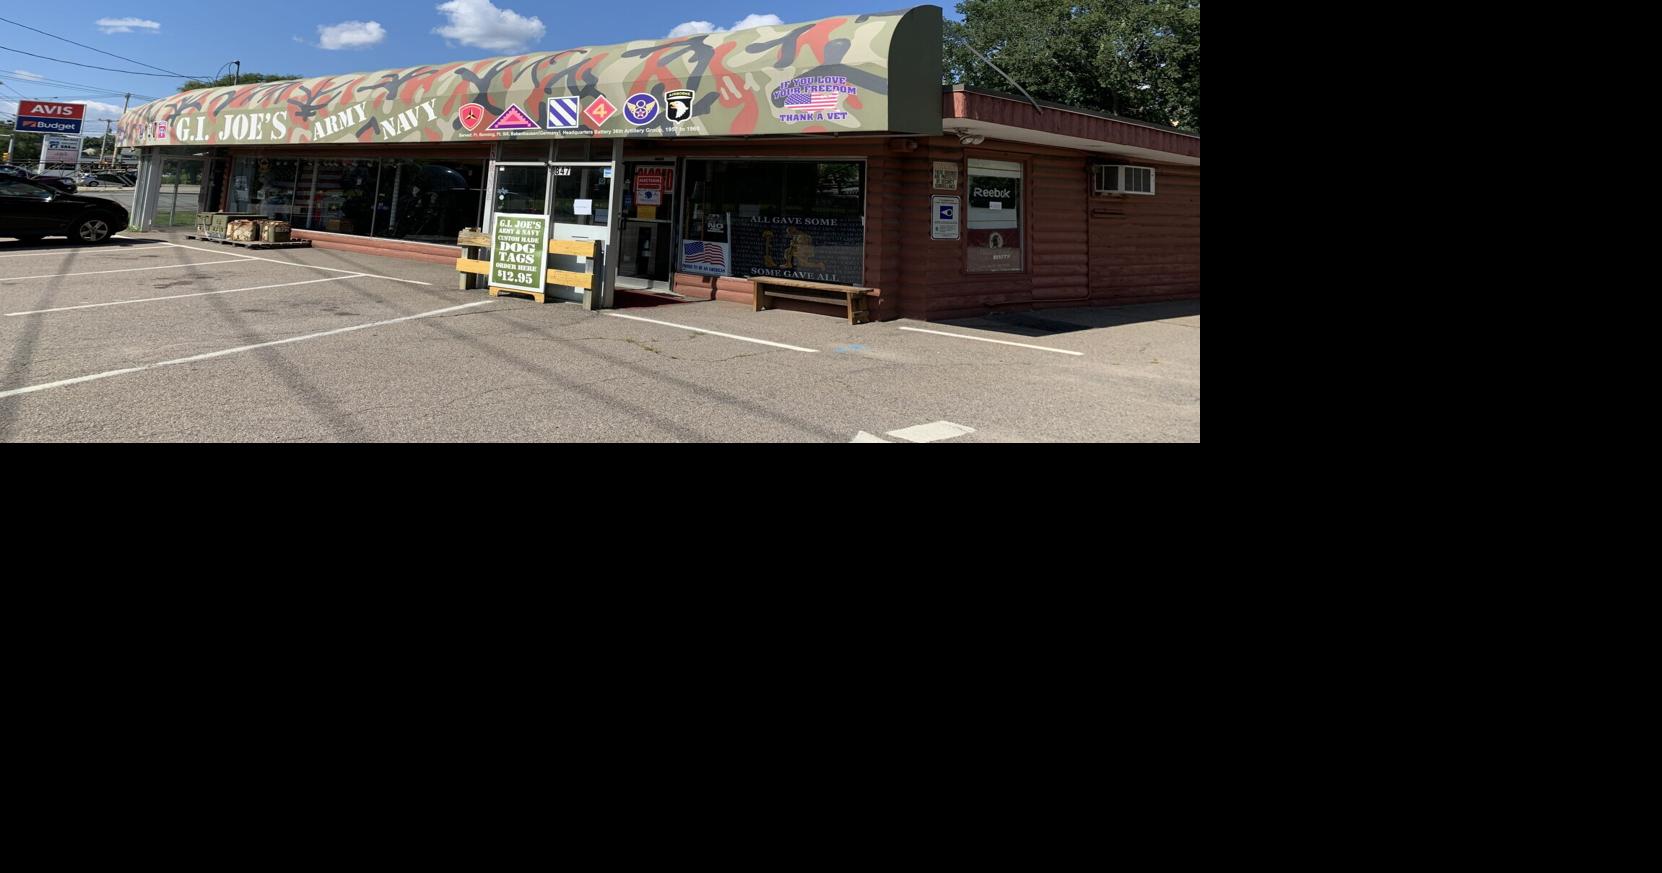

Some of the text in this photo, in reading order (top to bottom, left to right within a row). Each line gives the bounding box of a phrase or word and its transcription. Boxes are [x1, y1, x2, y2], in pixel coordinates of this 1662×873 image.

[780, 76, 847, 89] IF YOU LOVE
[773, 85, 857, 99] YOUR FREEDOM
[31, 104, 73, 116] AVIS
[592, 103, 607, 118] 4
[313, 98, 438, 141] ARMY NAVY
[779, 113, 813, 122] THANK
[826, 111, 848, 120] VET
[37, 121, 76, 131] Budget
[175, 111, 288, 141] G.I. JOE'S
[973, 187, 1011, 198] Reebok
[499, 219, 541, 230] G.I. JOE'S
[750, 215, 838, 226] ALL GAVE SOME
[498, 227, 514, 235] ARMY
[499, 242, 536, 254] DOG
[498, 251, 535, 264] TAGS
[495, 262, 517, 270] ORDER
[497, 270, 533, 284] $12.95
[751, 267, 840, 282] SOME GAVE ALL
